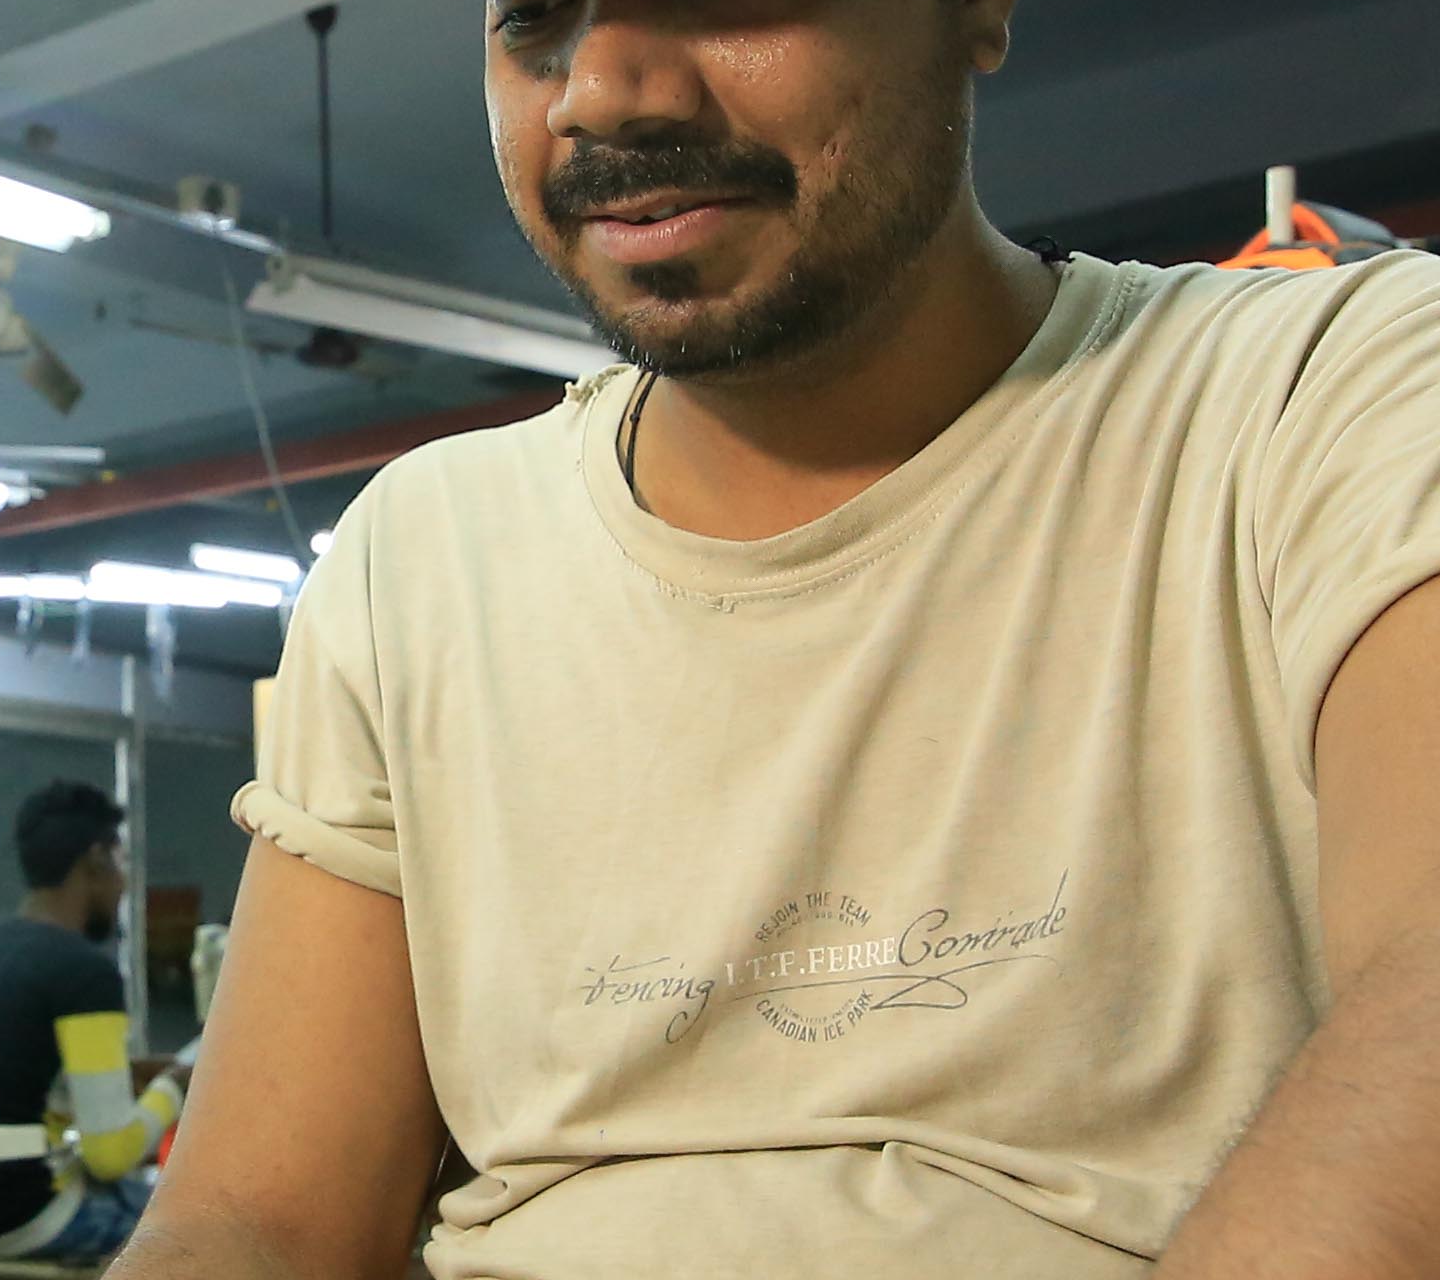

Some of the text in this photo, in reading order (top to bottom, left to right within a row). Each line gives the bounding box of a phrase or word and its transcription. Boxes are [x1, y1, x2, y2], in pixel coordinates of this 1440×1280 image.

[754, 901, 799, 944] REJOIN
[806, 890, 832, 908] THE
[839, 895, 872, 928] TEAM
[898, 867, 1069, 967] Comrade
[755, 998, 818, 1043] CANADIAN
[823, 1021, 846, 1042] ICE
[846, 988, 874, 1028] PARK
